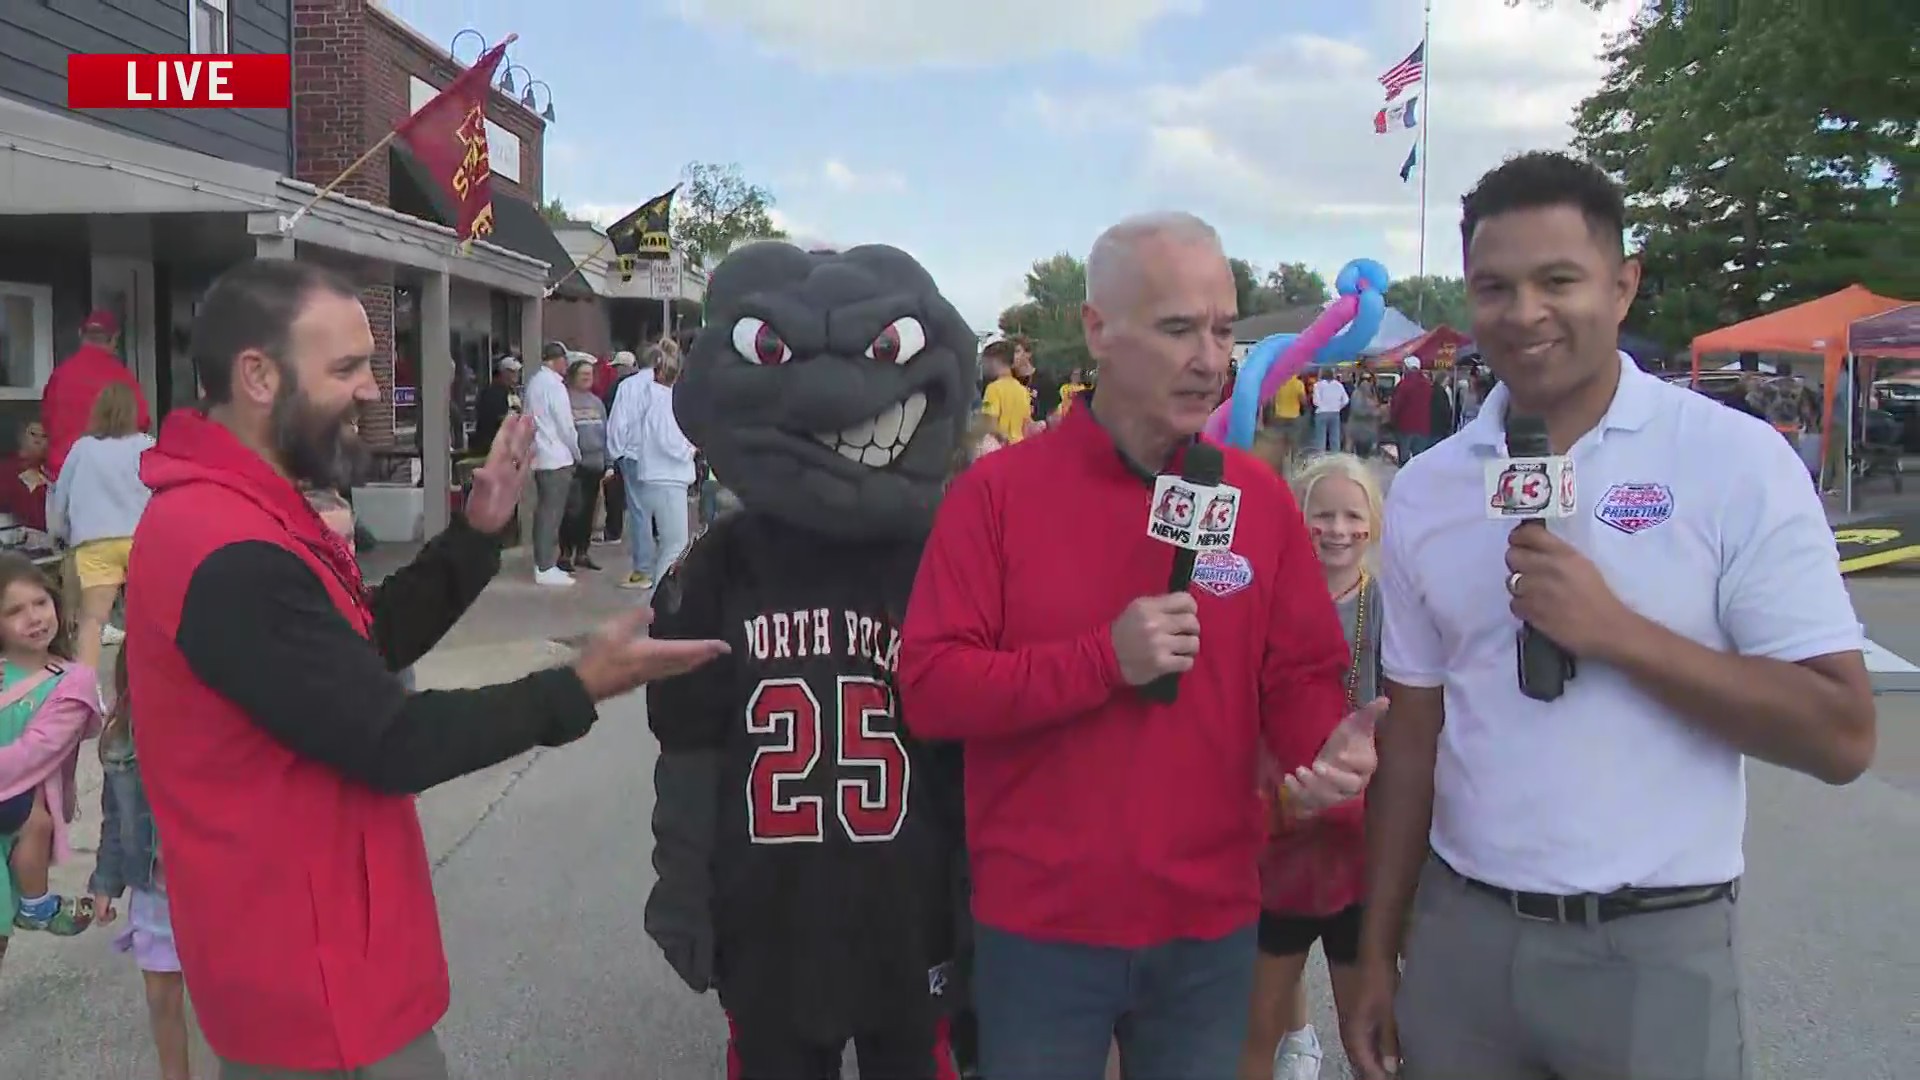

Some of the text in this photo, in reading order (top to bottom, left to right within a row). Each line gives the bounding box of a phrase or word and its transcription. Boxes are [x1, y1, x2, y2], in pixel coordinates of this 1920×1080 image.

[1151, 521, 1191, 544] NEWS
[1196, 533, 1231, 546] NEWS
[746, 675, 910, 842] 25
